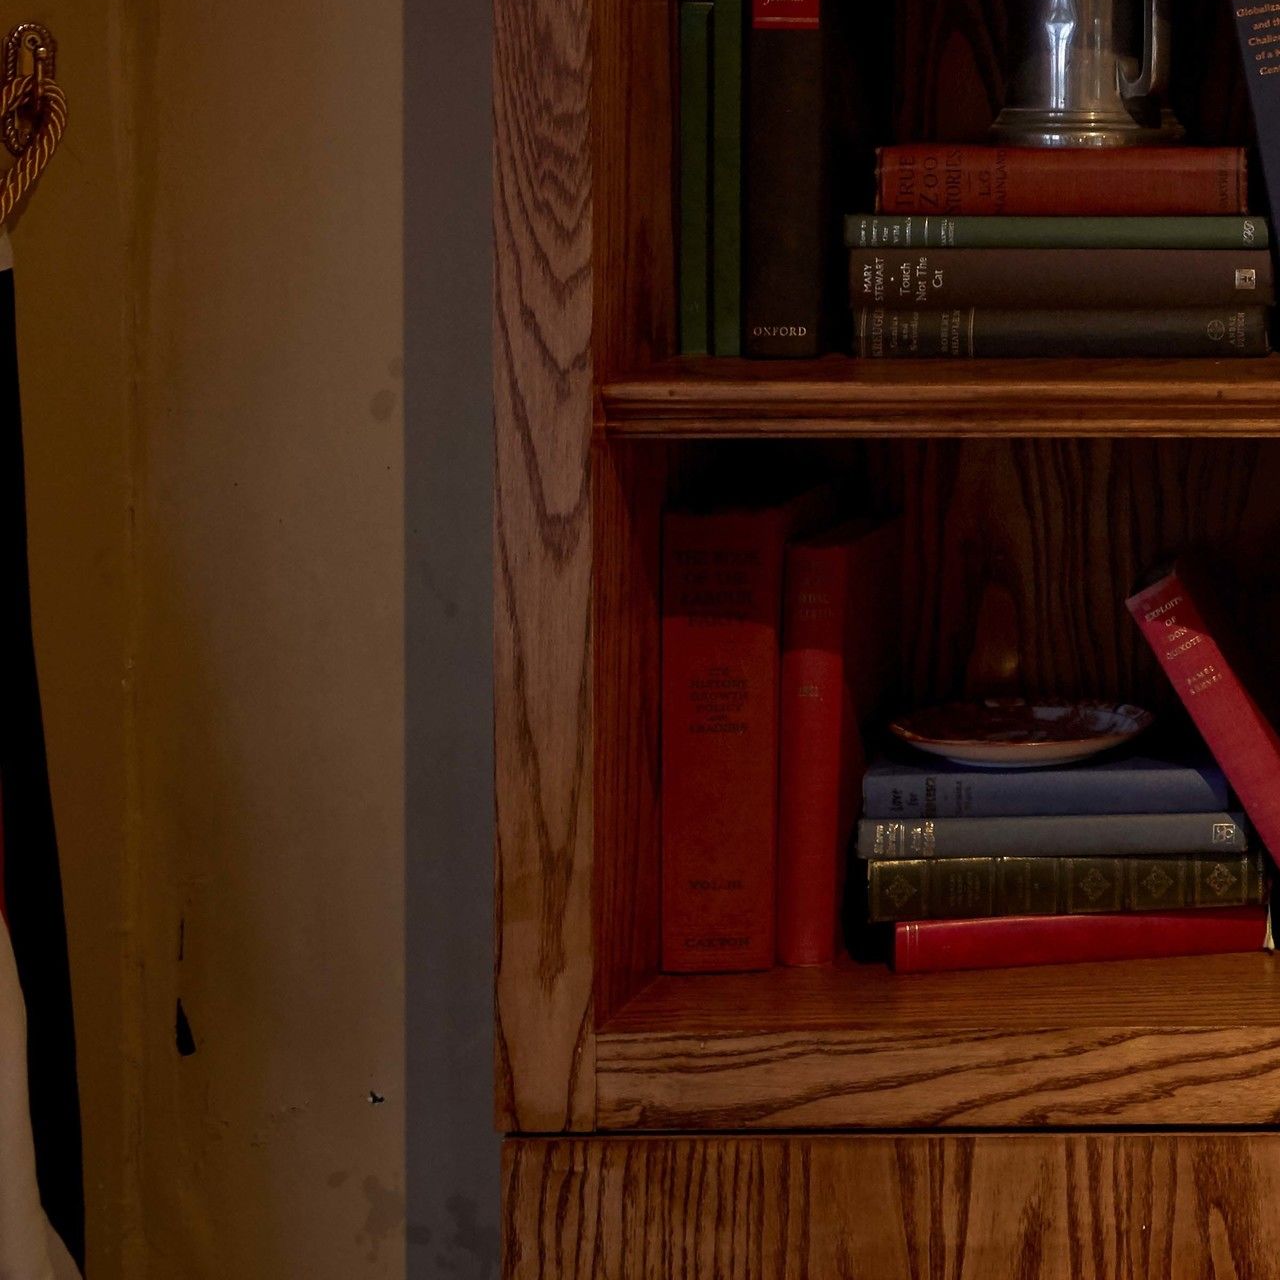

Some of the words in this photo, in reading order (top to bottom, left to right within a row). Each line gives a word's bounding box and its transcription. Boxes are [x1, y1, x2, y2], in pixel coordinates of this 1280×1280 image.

[1252, 18, 1270, 31] and
[1255, 49, 1266, 61] of
[896, 154, 916, 207] TRUE
[919, 156, 939, 209] ZOO
[916, 256, 927, 277] The
[863, 263, 872, 293] MARY
[875, 256, 884, 301] STEWART
[900, 262, 911, 296] Touch
[932, 268, 944, 288] Cat
[916, 280, 927, 301] Not
[752, 325, 807, 337] OXFORD
